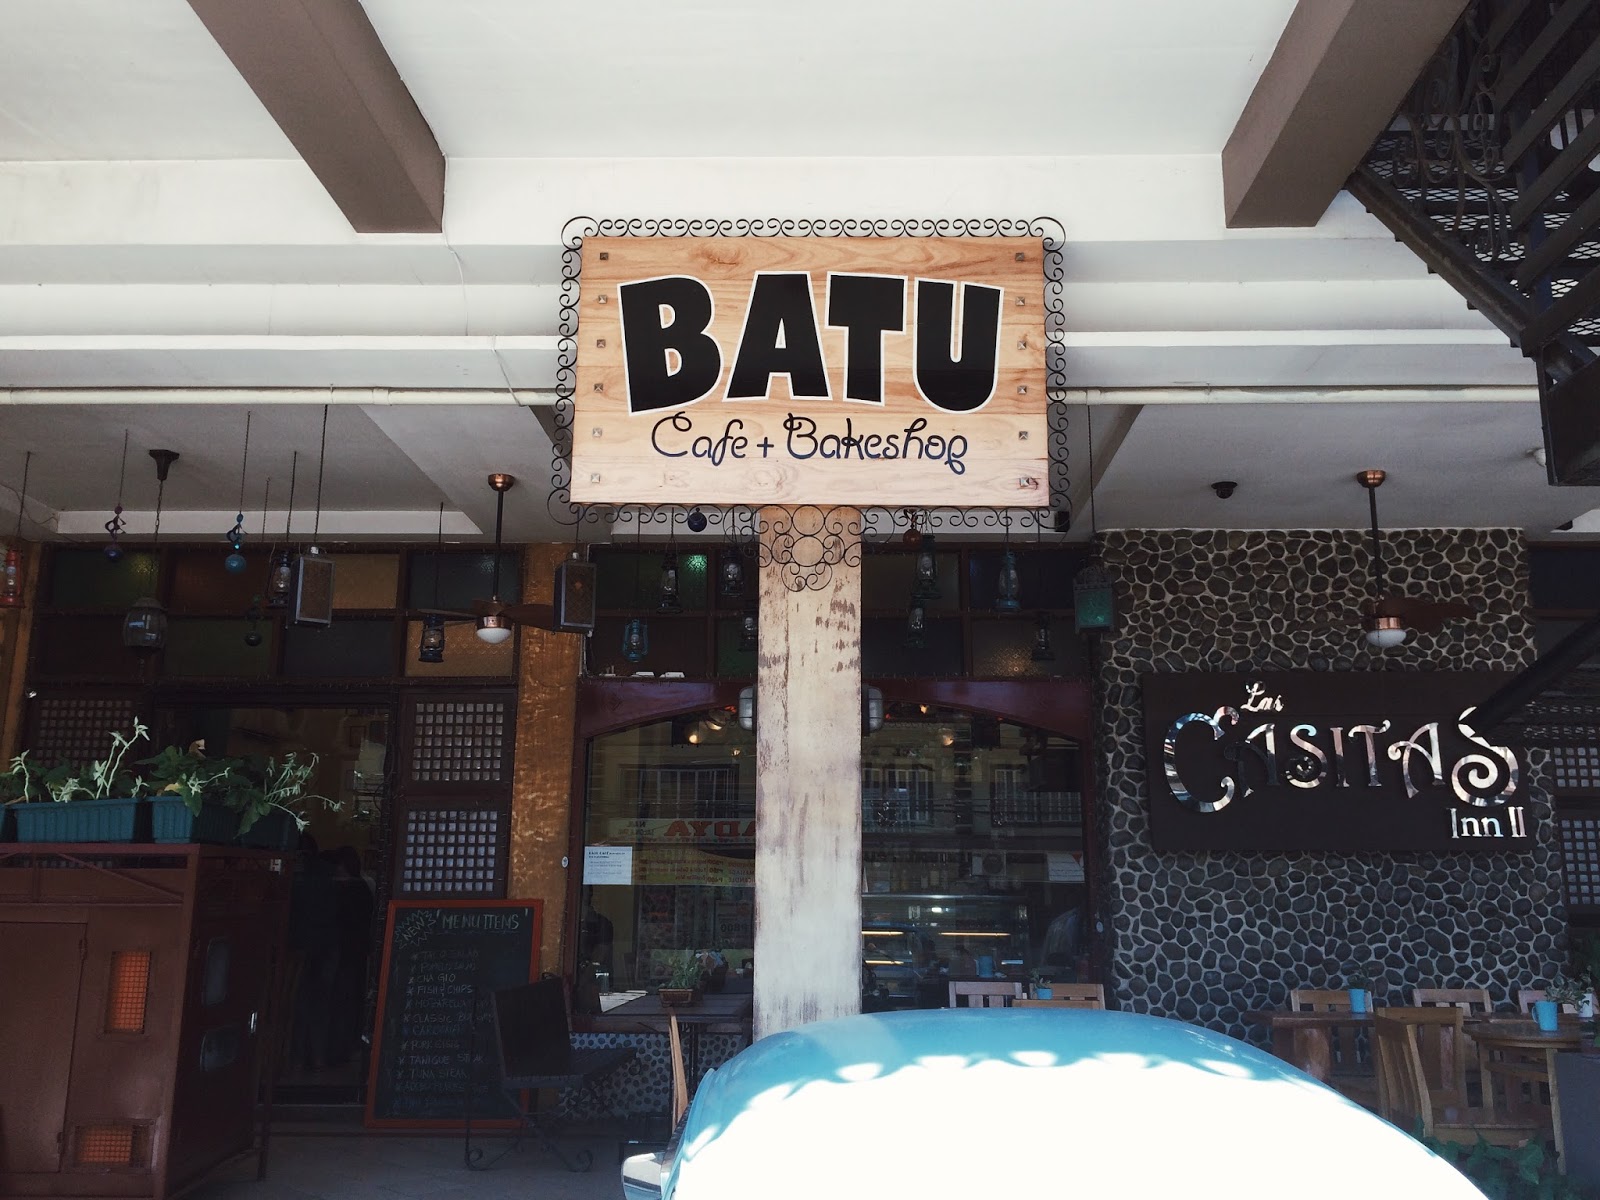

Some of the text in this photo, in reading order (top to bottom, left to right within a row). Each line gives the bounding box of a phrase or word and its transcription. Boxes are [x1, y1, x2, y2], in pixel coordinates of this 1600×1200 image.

[616, 270, 1005, 415] BATU
[651, 412, 747, 466] Cafe
[783, 413, 968, 475] Bakeshop
[1163, 706, 1520, 813] CASITAS
[1450, 807, 1504, 839] Inn
[402, 917, 426, 941] NEW
[417, 985, 438, 995] FISH
[447, 983, 473, 994] CHIPS
